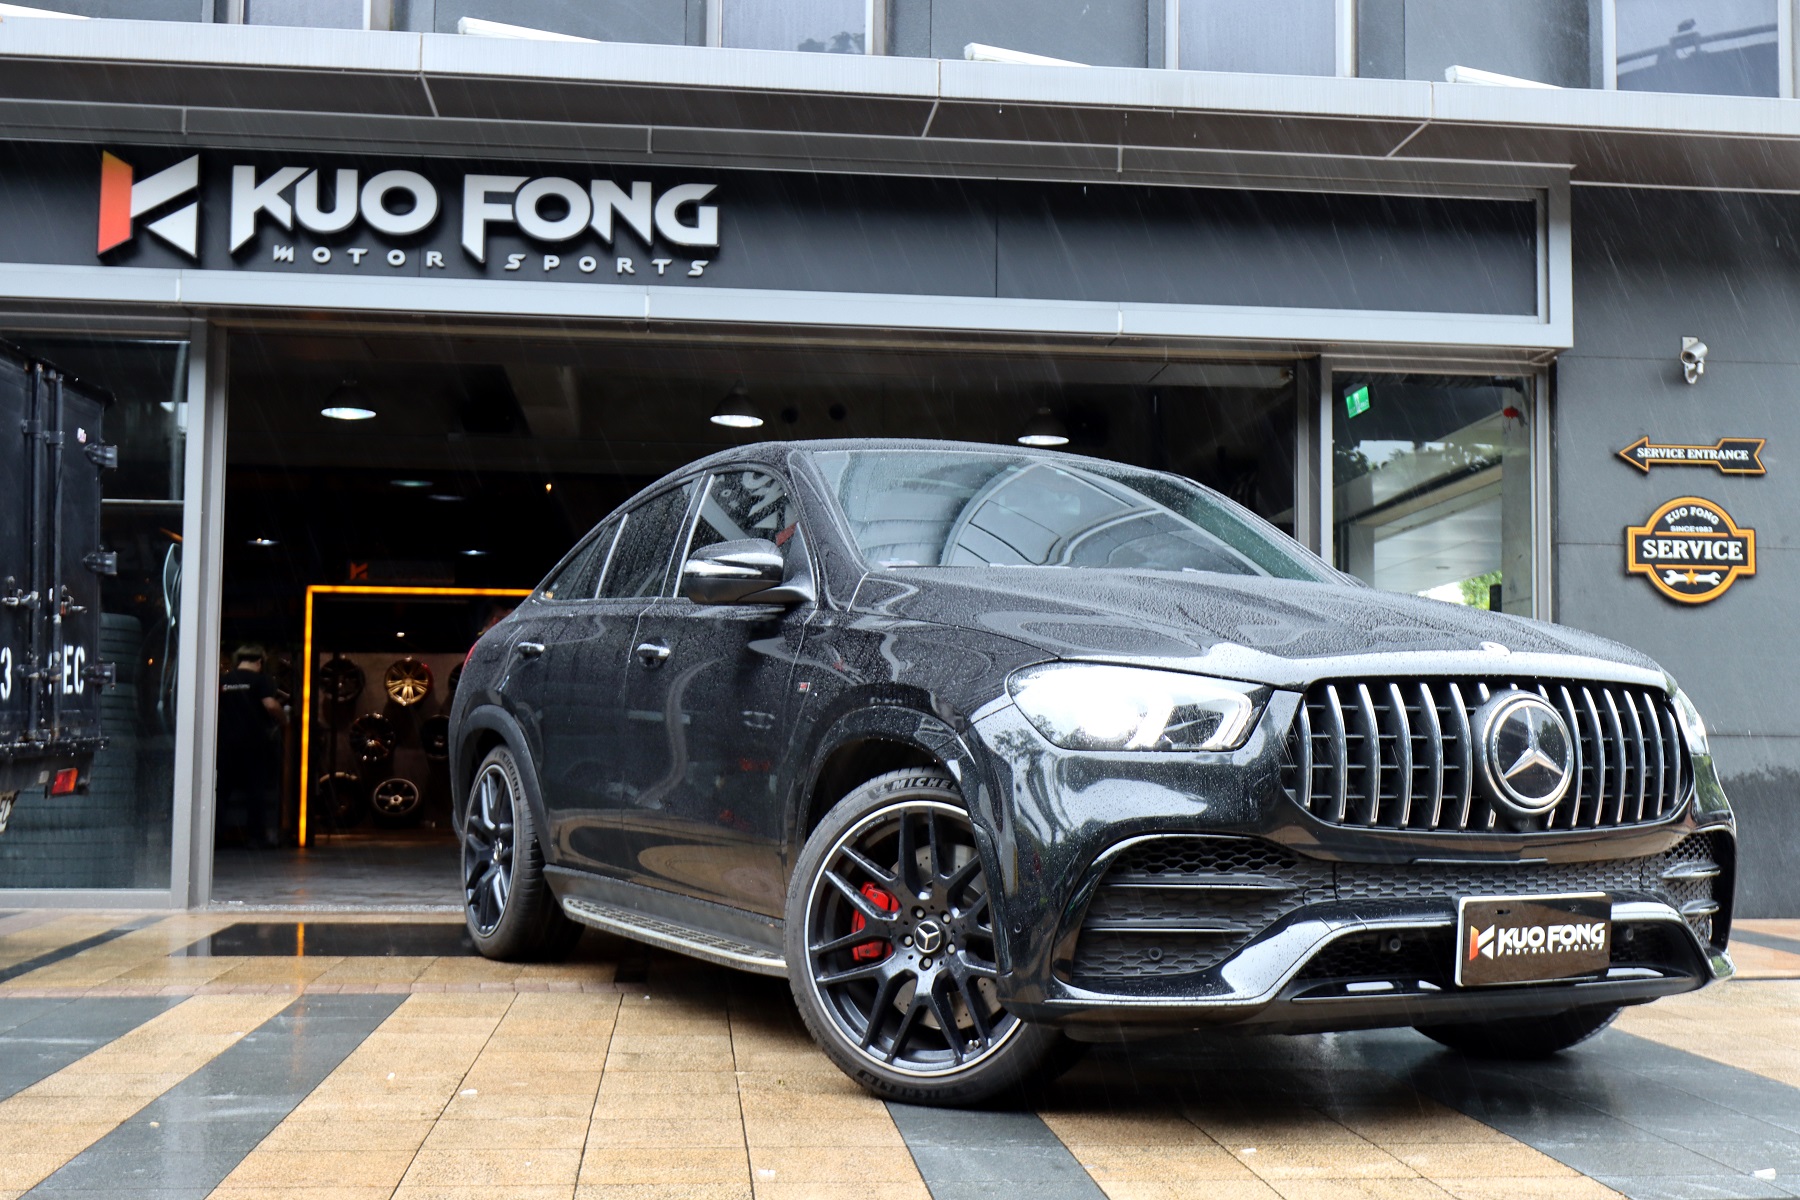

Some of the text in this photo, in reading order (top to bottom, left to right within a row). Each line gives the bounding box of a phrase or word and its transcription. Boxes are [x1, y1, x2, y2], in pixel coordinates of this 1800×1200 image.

[229, 165, 438, 254] KUO
[461, 174, 719, 263] FONG
[272, 245, 709, 277] MOTOR SPORTS
[1636, 447, 1749, 460] SERVICE ENTRANCE
[1664, 506, 1719, 525] KUO FONG
[1642, 539, 1743, 561] SERVICE
[1497, 926, 1545, 956] KUO
[1547, 922, 1605, 954] FONG
[1506, 943, 1604, 955] MOTOR SPORTS
